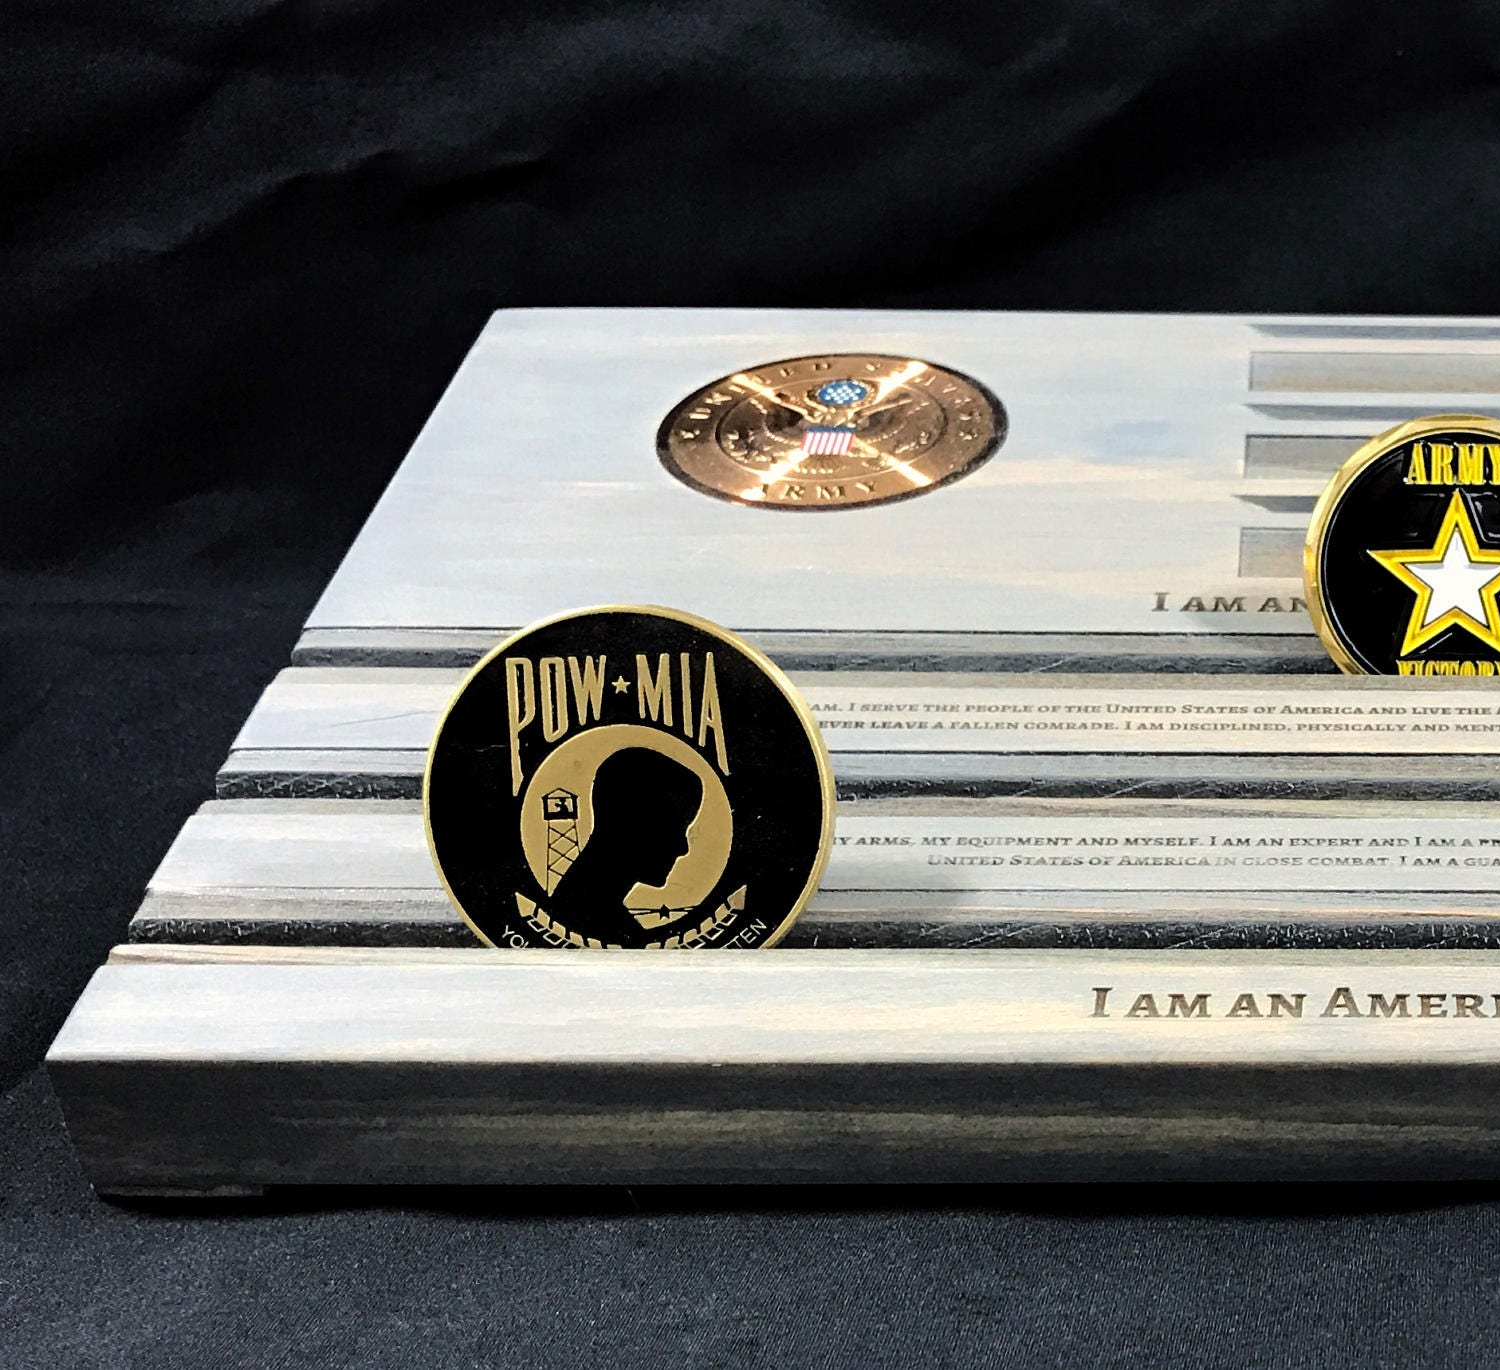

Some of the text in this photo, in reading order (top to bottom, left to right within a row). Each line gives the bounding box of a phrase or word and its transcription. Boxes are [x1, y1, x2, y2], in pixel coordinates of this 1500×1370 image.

[1152, 592, 1170, 612] I
[1180, 596, 1247, 612] AM
[810, 704, 842, 712] AM.
[860, 704, 918, 712] SERVE
[924, 704, 961, 712] THE
[965, 704, 1033, 713] PEOPLE
[1037, 704, 1060, 713] OF
[1065, 704, 1101, 713] THE
[1106, 703, 1177, 713] UNITED
[1181, 704, 1249, 713] STATES
[1253, 705, 1276, 713] OF
[1280, 704, 1363, 713] AMERICA
[1368, 705, 1407, 714] AND
[1412, 705, 1452, 714] LIVE
[1455, 705, 1492, 714] THE
[505, 651, 729, 797] POW MIA
[818, 721, 866, 729] EVER
[870, 721, 928, 729] LEAVE
[932, 721, 944, 730] A
[950, 721, 1019, 730] FALLEN
[1024, 722, 1118, 730] COMRADE.
[1137, 722, 1164, 731] AM
[1296, 723, 1409, 731] PHYSICALLY
[1411, 723, 1450, 732] AND
[921, 837, 952, 846] MY
[956, 837, 1072, 846] EQUIPMENT
[1076, 837, 1118, 846] AND
[1222, 838, 1250, 847] AM
[1257, 838, 1284, 847] AN
[1289, 838, 1364, 847] EXPERT
[1368, 838, 1409, 847] AND
[1428, 838, 1456, 847] AM
[1460, 838, 1473, 847] A
[927, 855, 1004, 866] UNITED
[1009, 855, 1083, 866] STATES
[1088, 857, 1111, 866] OF
[1117, 855, 1210, 866] AMERICA
[1213, 857, 1236, 866] IN
[1242, 857, 1302, 866] CLOSE
[1412, 858, 1441, 867] AM
[1447, 858, 1459, 867] A
[1089, 986, 1114, 1018] I
[1124, 993, 1212, 1018] AM
[1225, 993, 1308, 1018] AN
